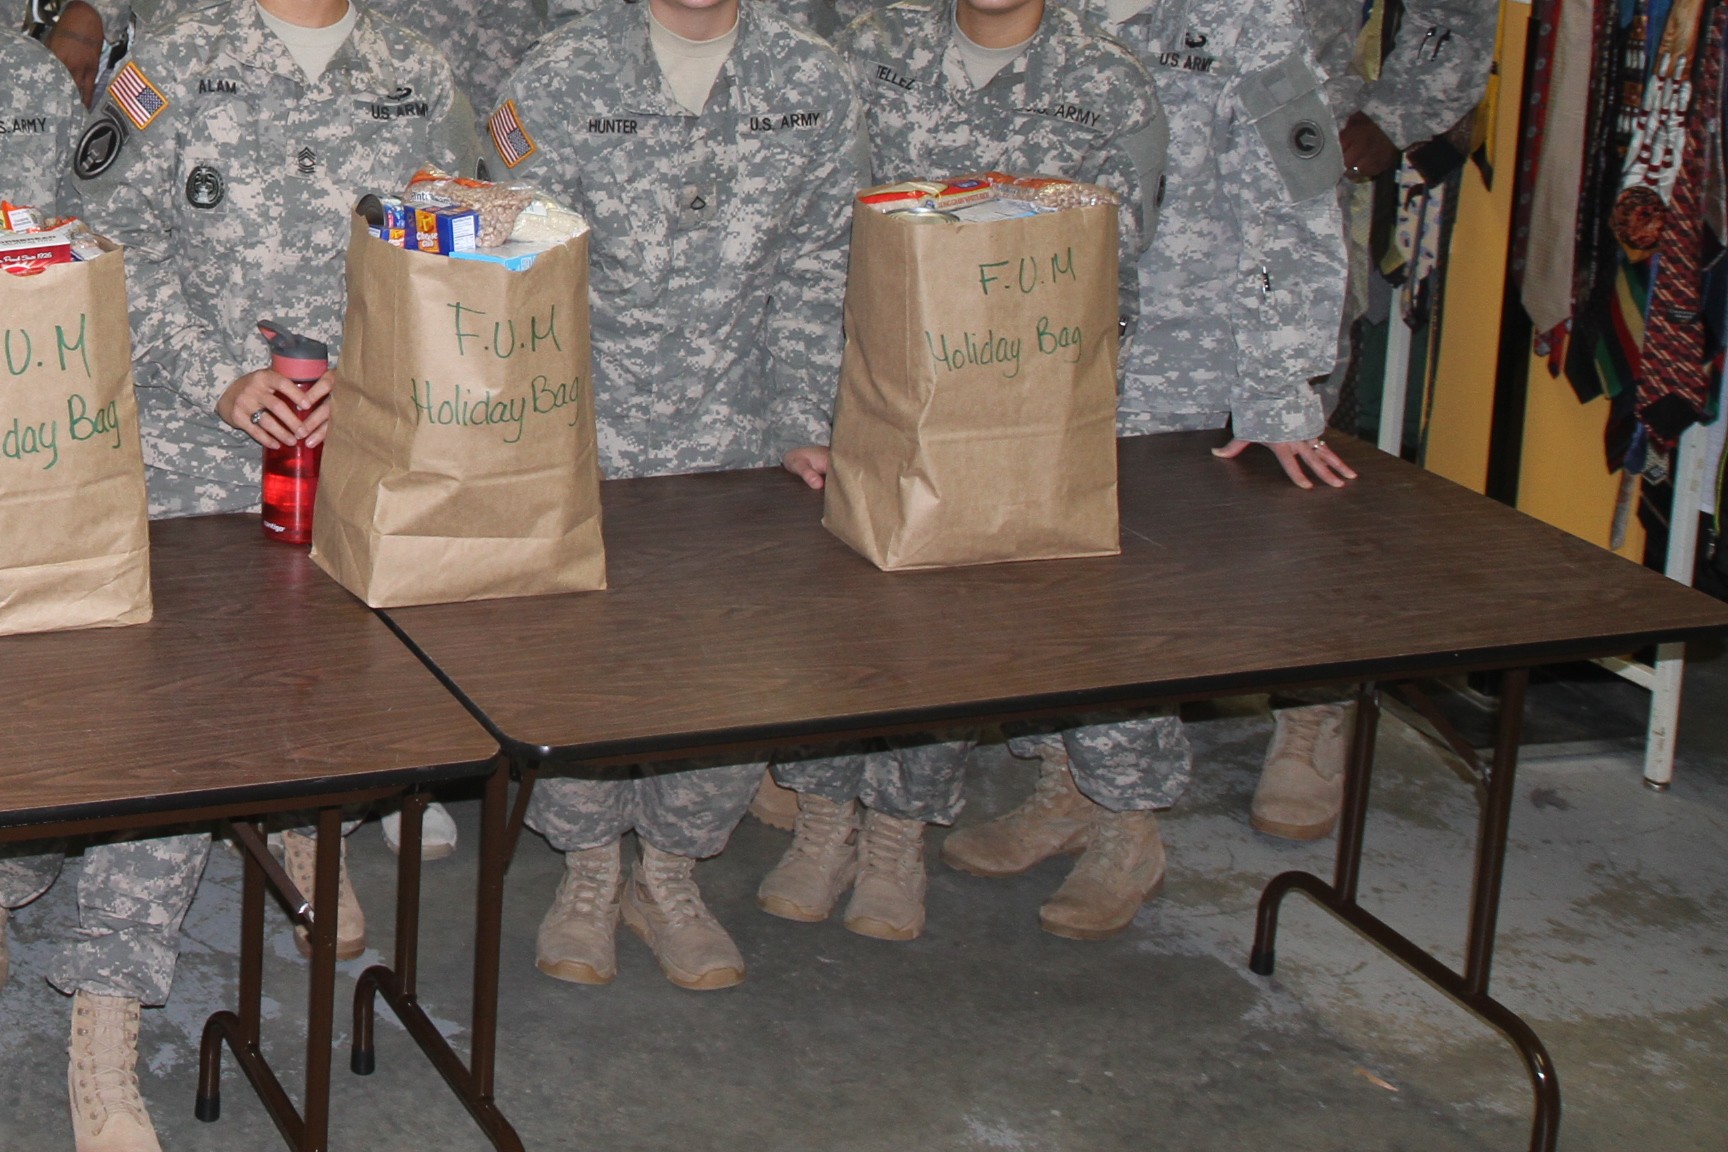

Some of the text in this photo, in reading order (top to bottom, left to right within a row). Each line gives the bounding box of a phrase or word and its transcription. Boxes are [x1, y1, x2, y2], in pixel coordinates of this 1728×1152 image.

[198, 79, 237, 95] ALAM
[876, 64, 917, 91] TELLEZ
[12, 117, 47, 133] ARMY
[588, 118, 638, 135] HUNTER
[780, 112, 821, 130] ARMY
[1054, 104, 1100, 127] ARMY
[924, 316, 1083, 379] Holiday Bag
[410, 375, 580, 444] Holiday Bag
[67, 393, 121, 450] Bag
